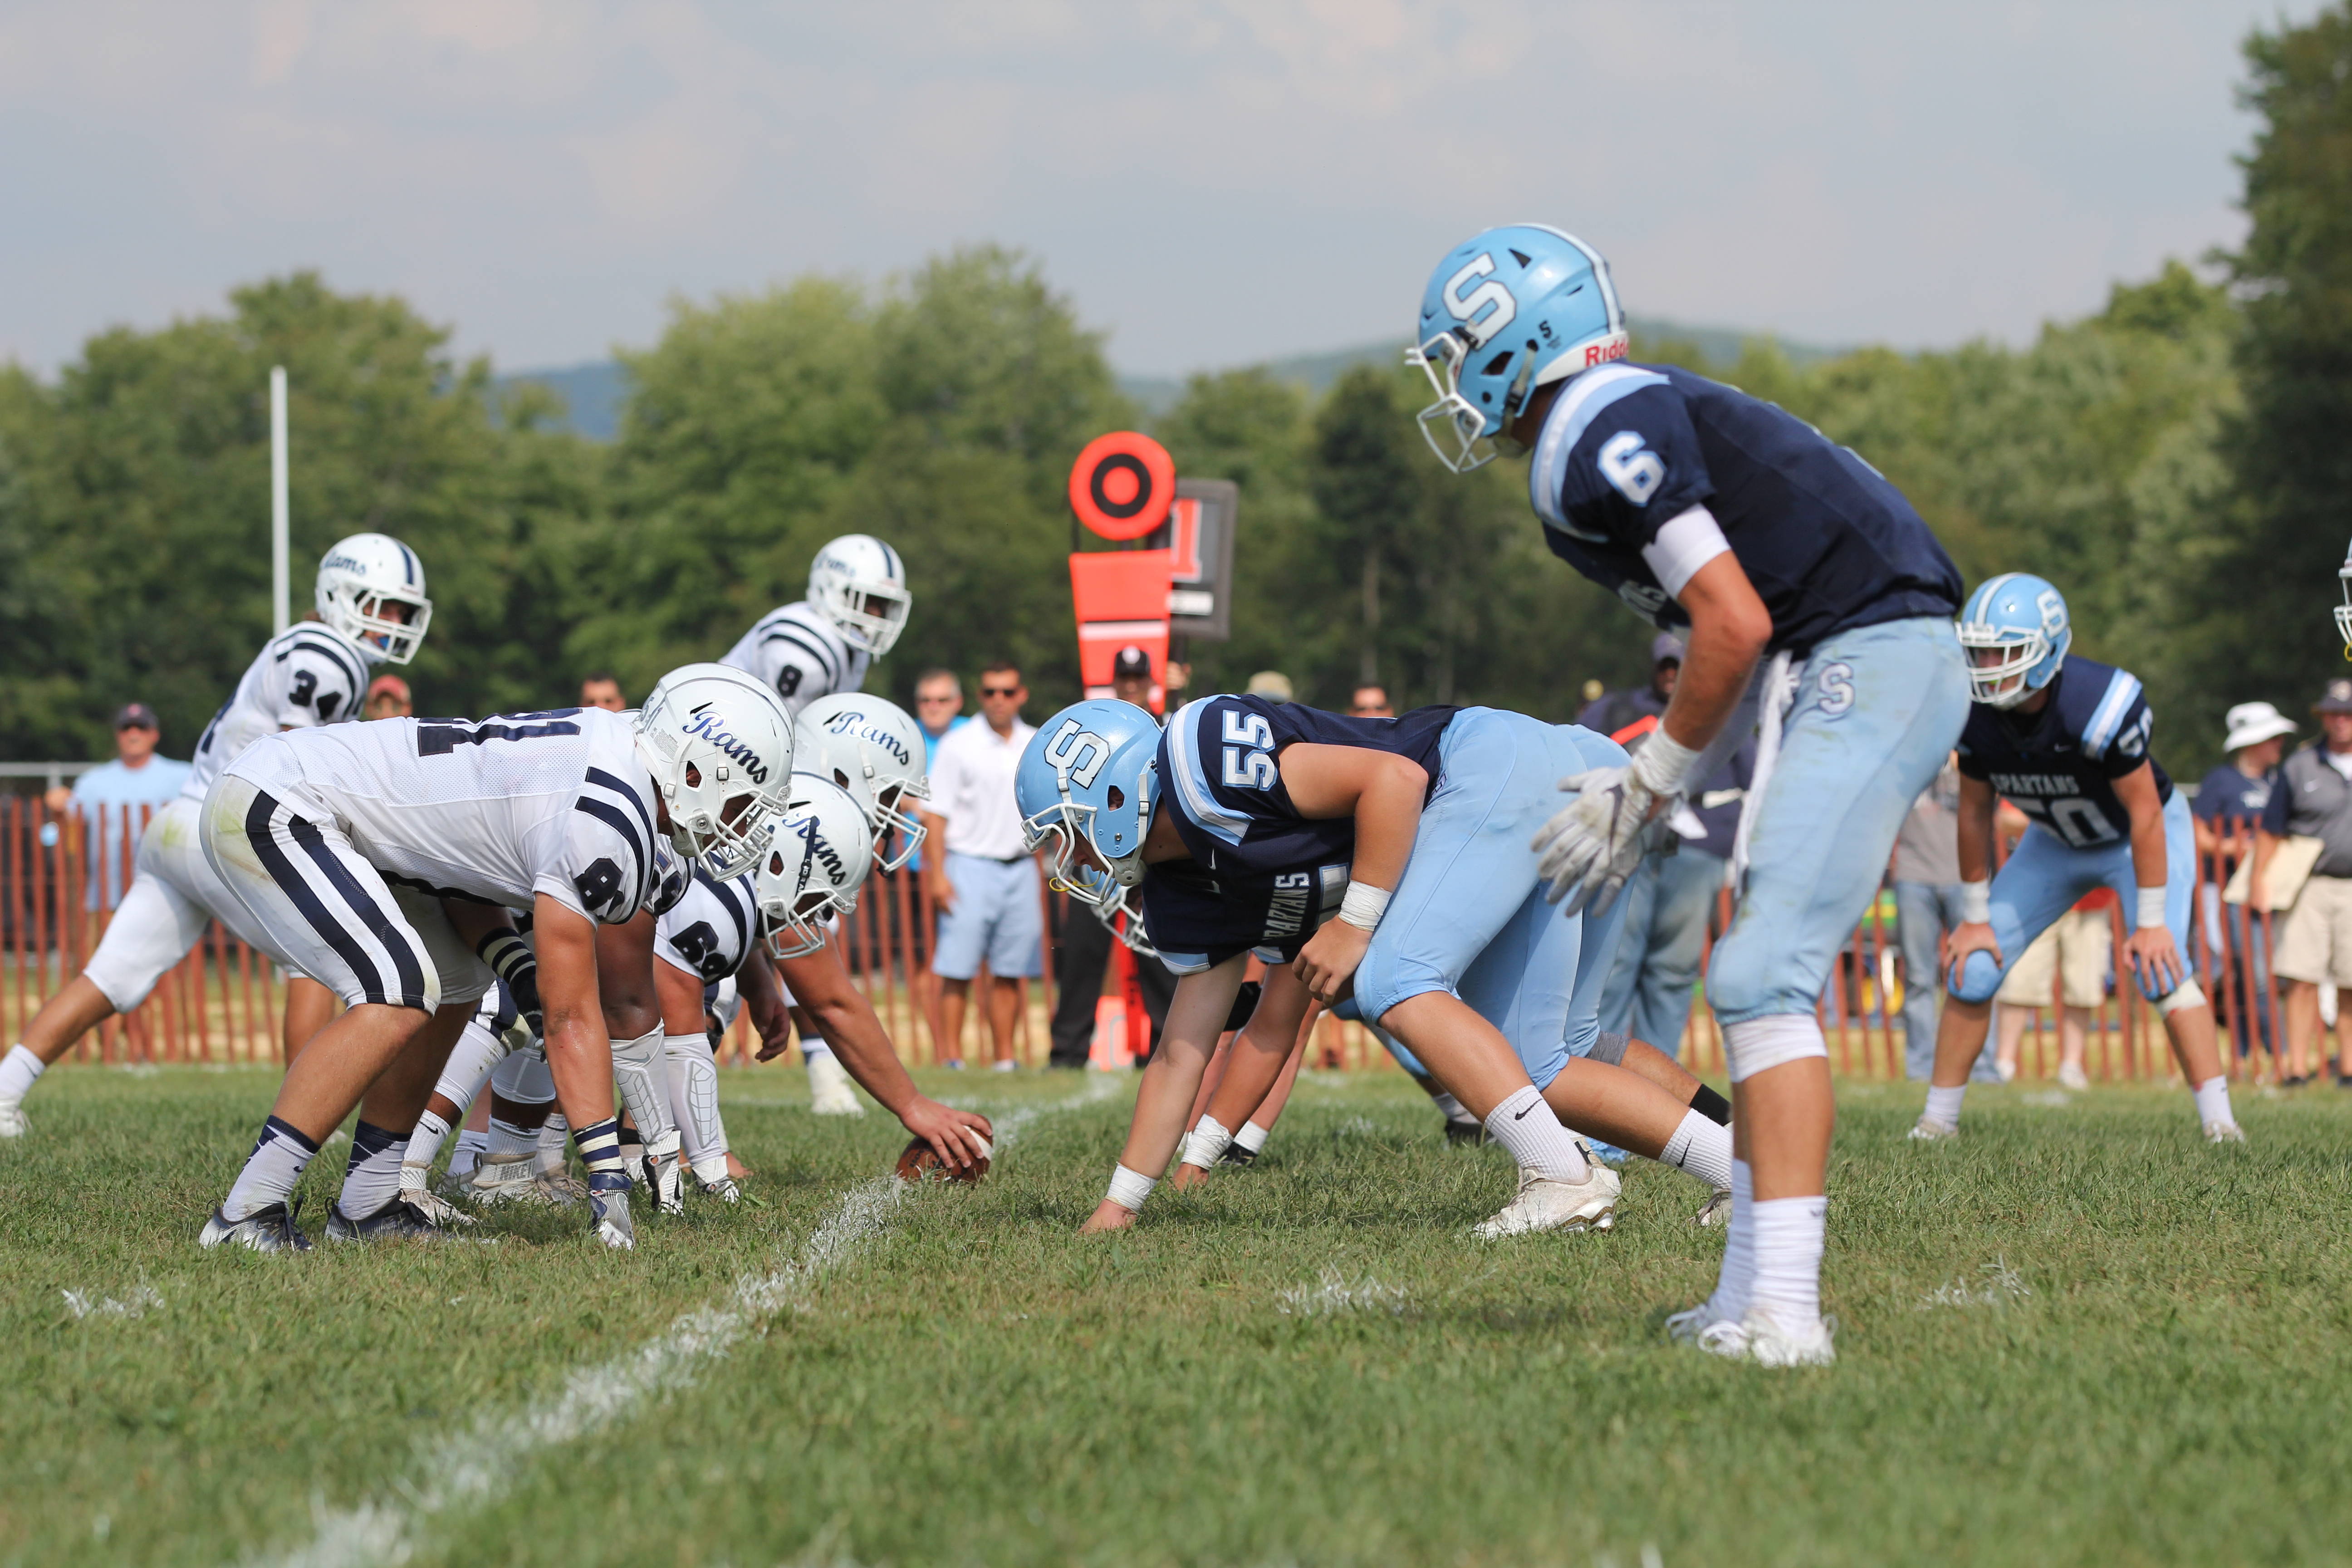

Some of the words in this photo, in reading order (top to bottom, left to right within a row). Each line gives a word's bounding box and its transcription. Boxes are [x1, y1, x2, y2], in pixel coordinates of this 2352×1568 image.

[1442, 252, 1517, 353] S
[1597, 430, 1667, 508] 6
[1818, 663, 1855, 715] S
[682, 711, 768, 784] Rams
[831, 711, 909, 765] Rams
[1044, 718, 1111, 790] S
[1221, 709, 1278, 791] 55
[1261, 872, 1310, 941] PARTANS
